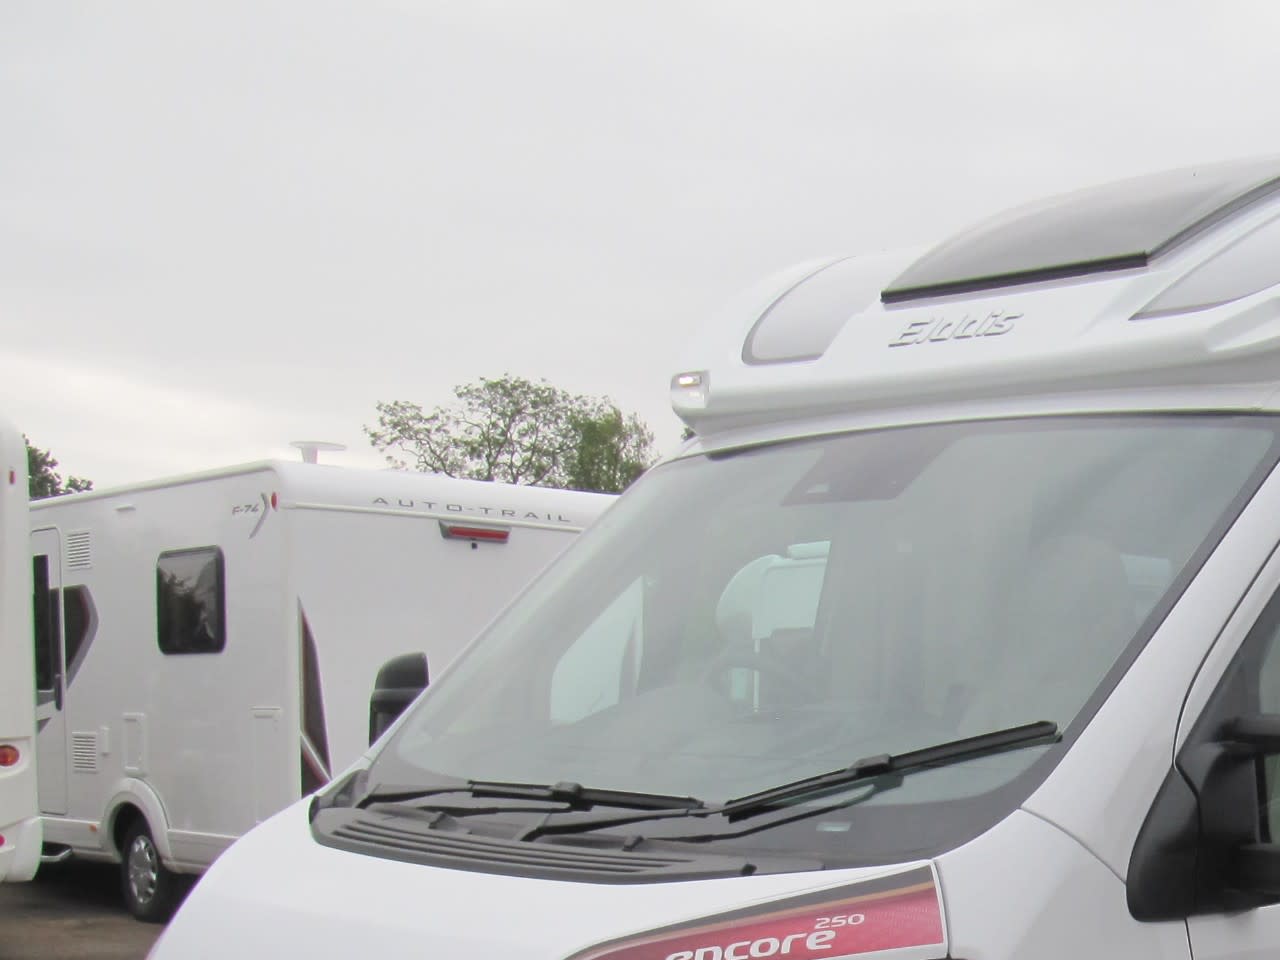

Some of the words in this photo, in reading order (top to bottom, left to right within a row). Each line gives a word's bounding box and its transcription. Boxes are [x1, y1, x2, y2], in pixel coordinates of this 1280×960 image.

[888, 309, 1025, 348] Elddis
[372, 497, 571, 523] AUTO-TRAIL
[814, 913, 865, 930] 250
